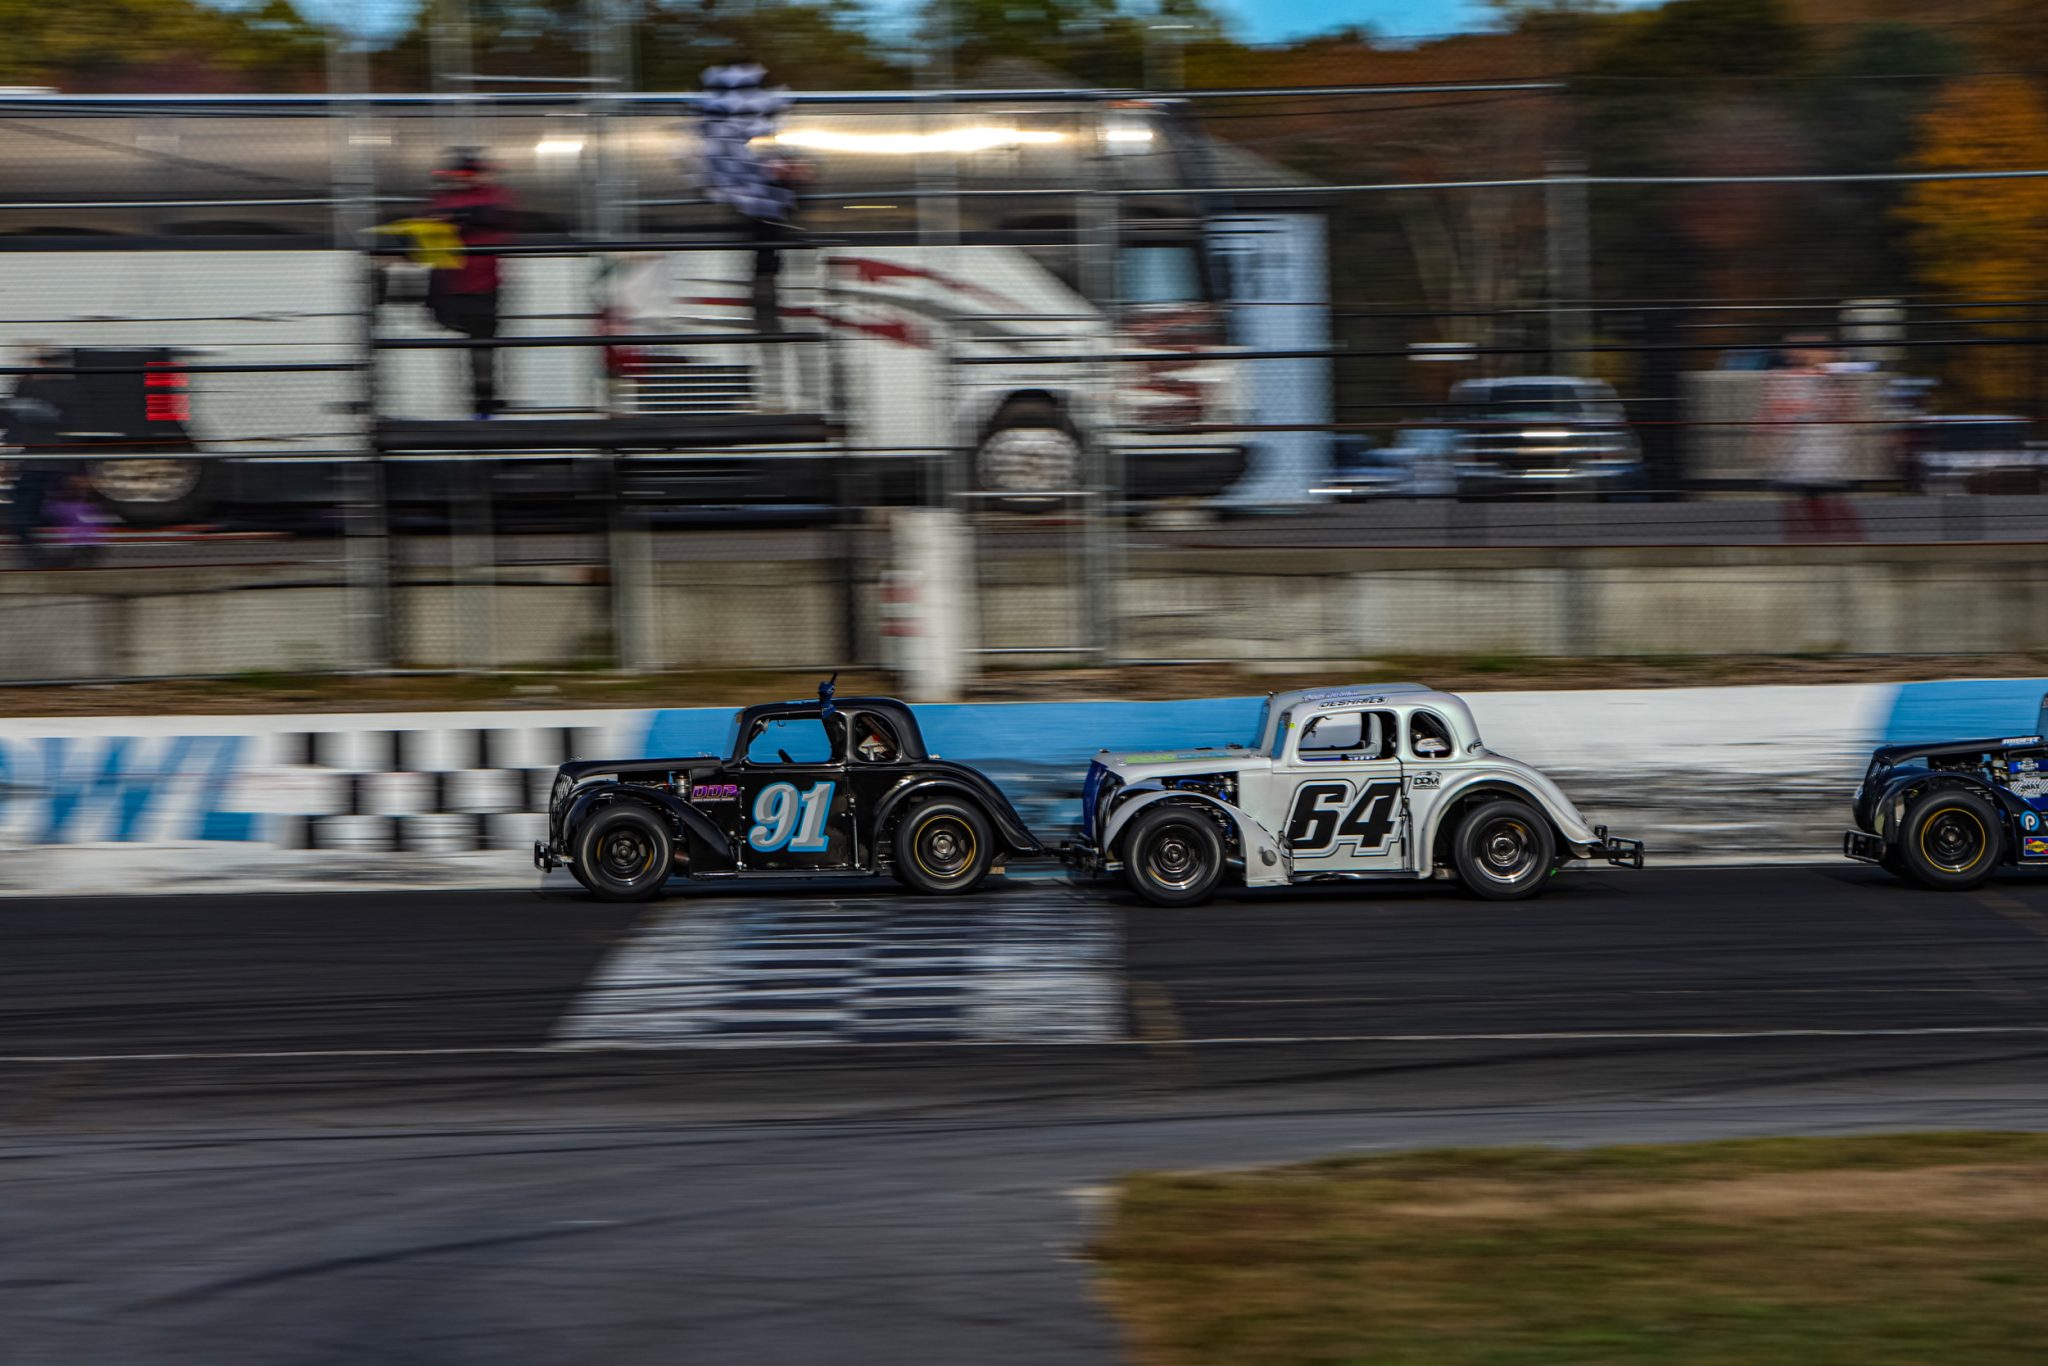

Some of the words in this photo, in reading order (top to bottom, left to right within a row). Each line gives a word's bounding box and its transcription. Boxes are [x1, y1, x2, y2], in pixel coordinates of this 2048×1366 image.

[692, 784, 738, 798] DDP
[748, 781, 835, 853] 91
[1287, 780, 1404, 850] 64
